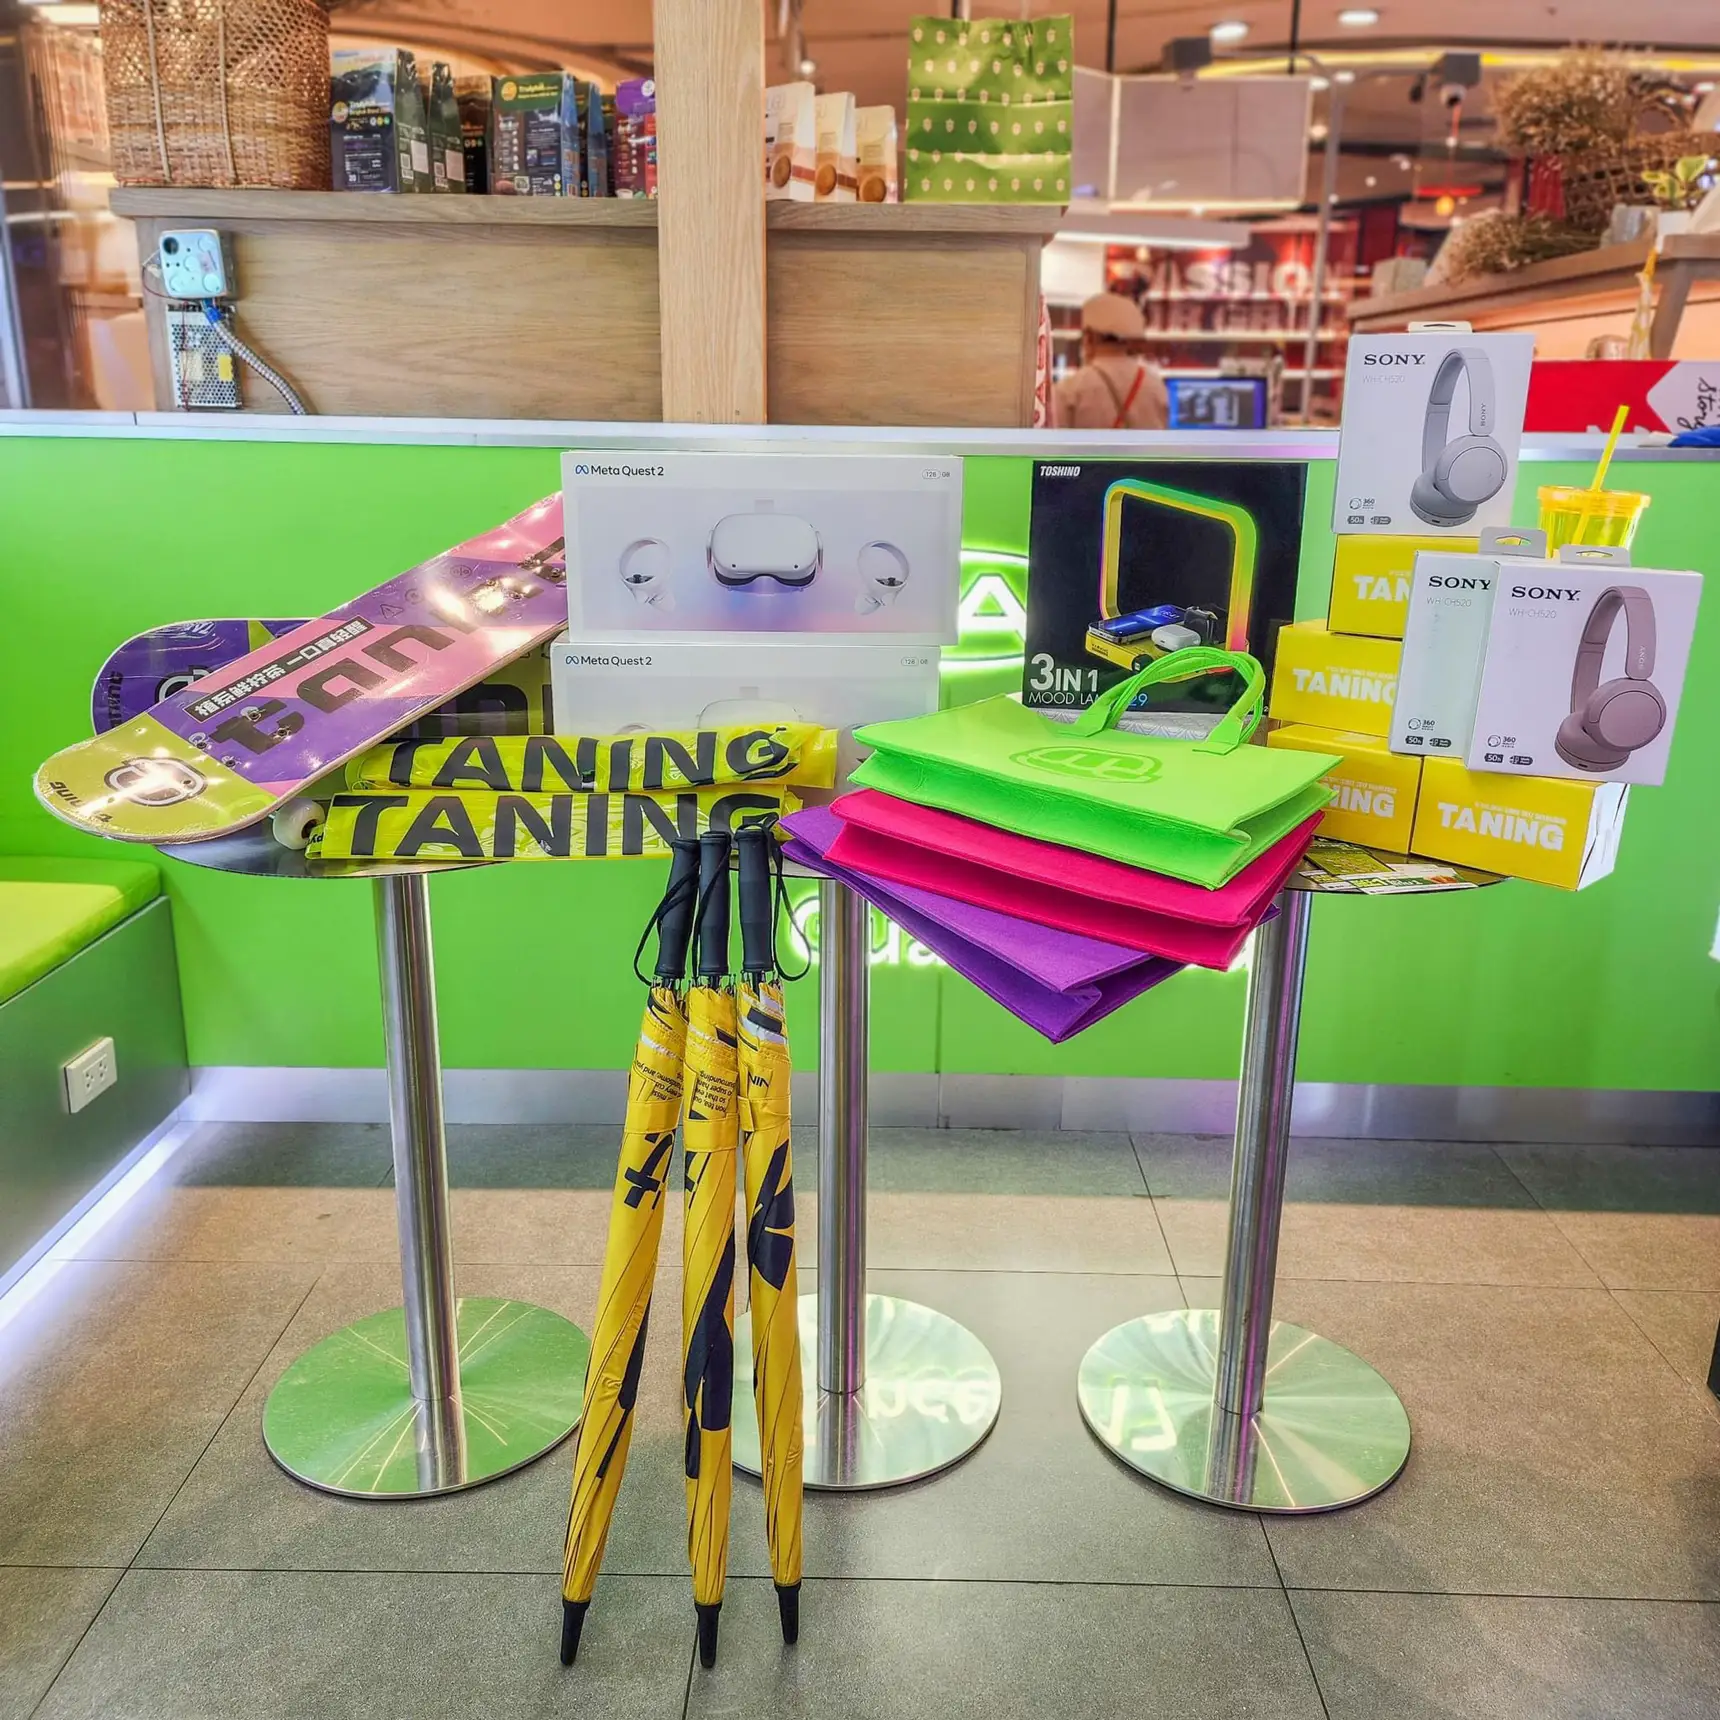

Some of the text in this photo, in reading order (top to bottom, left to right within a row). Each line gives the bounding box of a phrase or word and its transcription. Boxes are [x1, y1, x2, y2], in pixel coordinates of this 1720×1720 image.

[1363, 353, 1426, 366] SONY
[1362, 375, 1406, 384] WH-CH520
[1676, 376, 1718, 431] Story
[591, 465, 664, 476] Meta Quest 2
[1040, 465, 1081, 477] TOSHINO
[1428, 575, 1491, 590] SONY
[1511, 585, 1581, 601] SONY
[1426, 597, 1473, 608] WH-CH520
[1508, 607, 1557, 619] WH-CH520
[581, 655, 652, 666] Meta Quest 2
[1028, 692, 1075, 705] MOOD
[1080, 693, 1101, 706] LA
[389, 726, 798, 792] TANING
[332, 794, 780, 857] TANING
[1437, 801, 1565, 852] TANING
